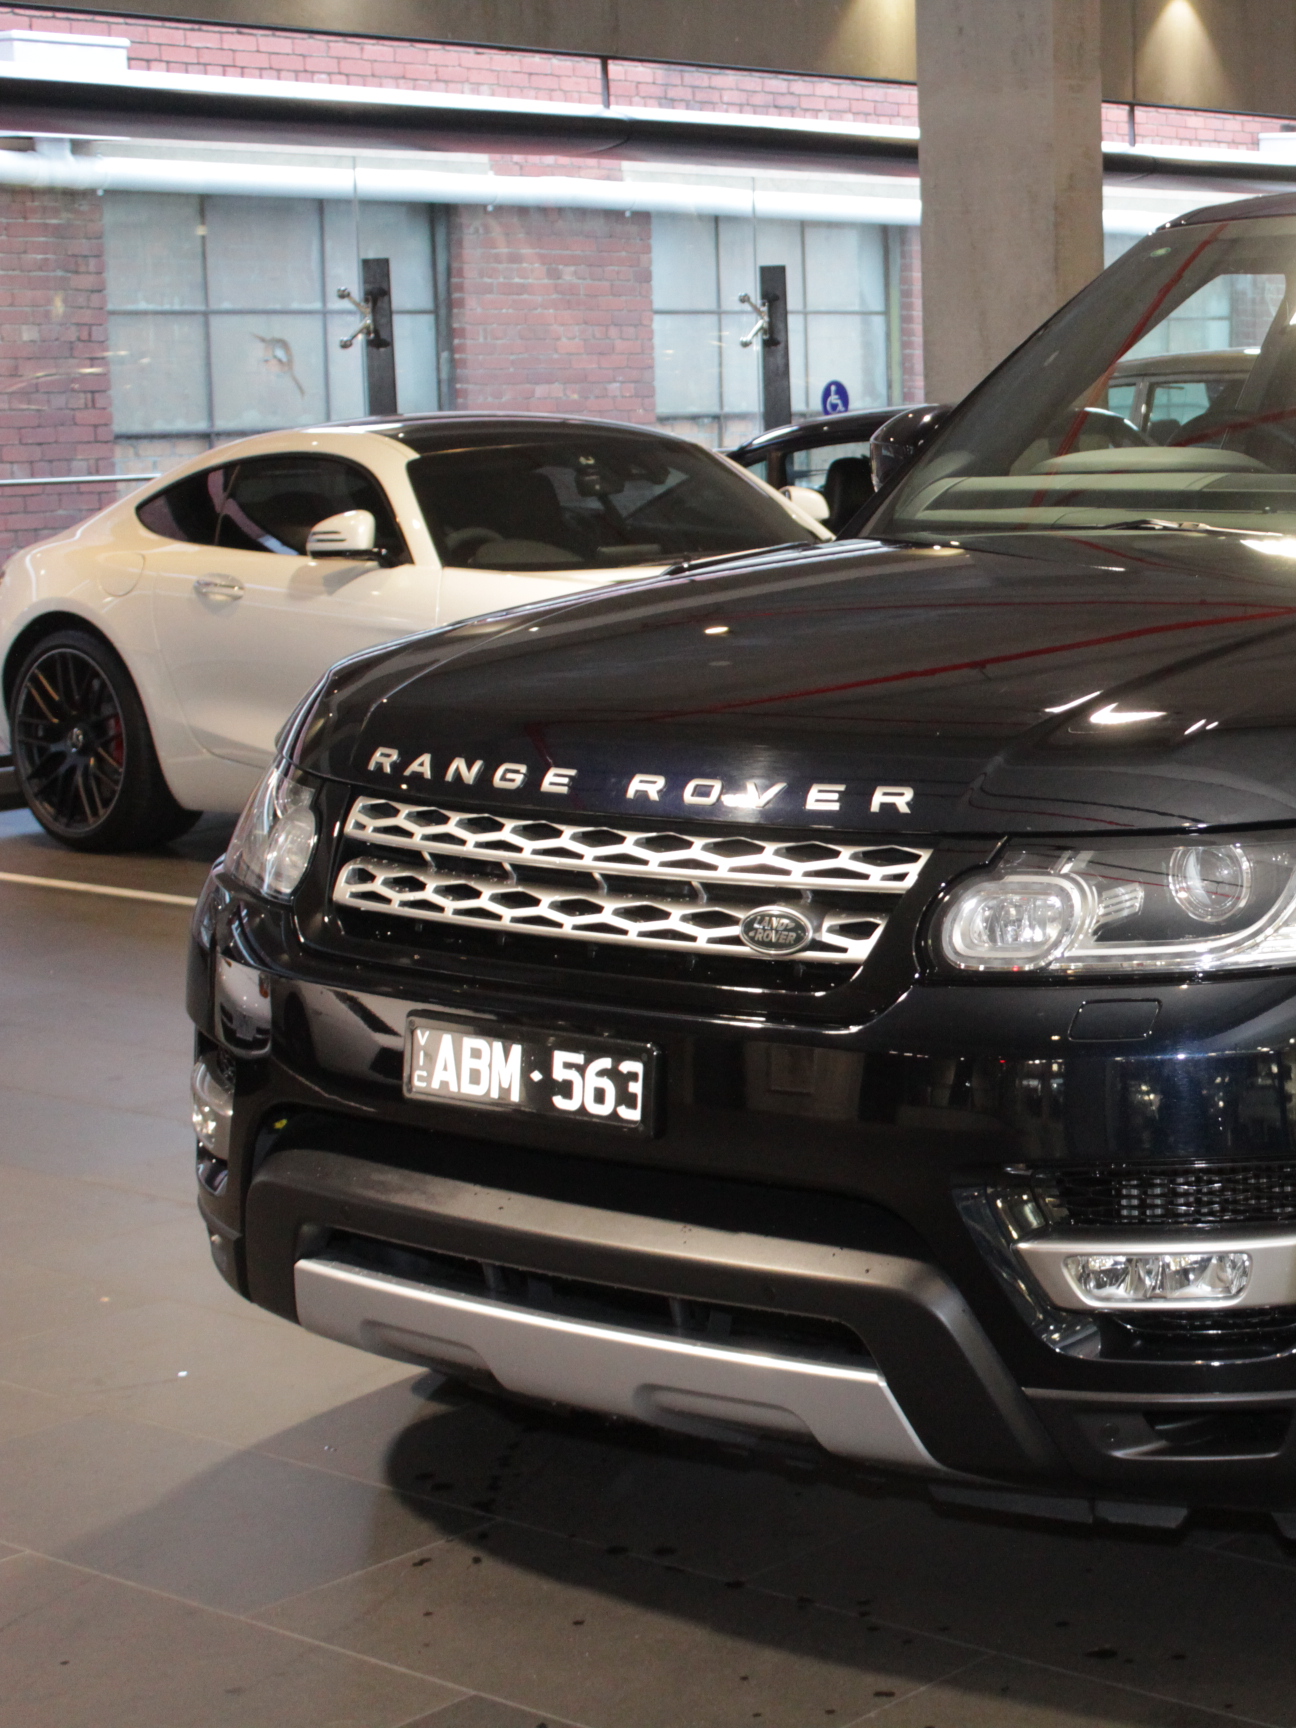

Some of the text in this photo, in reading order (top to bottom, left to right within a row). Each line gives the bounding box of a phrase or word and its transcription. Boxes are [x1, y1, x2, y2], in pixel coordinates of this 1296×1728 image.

[367, 746, 914, 814] RANGE ROVER
[753, 915, 786, 931] LAND
[755, 929, 797, 944] ROVER
[414, 1029, 429, 1088] VIC
[431, 1033, 644, 1122] ABM 563
